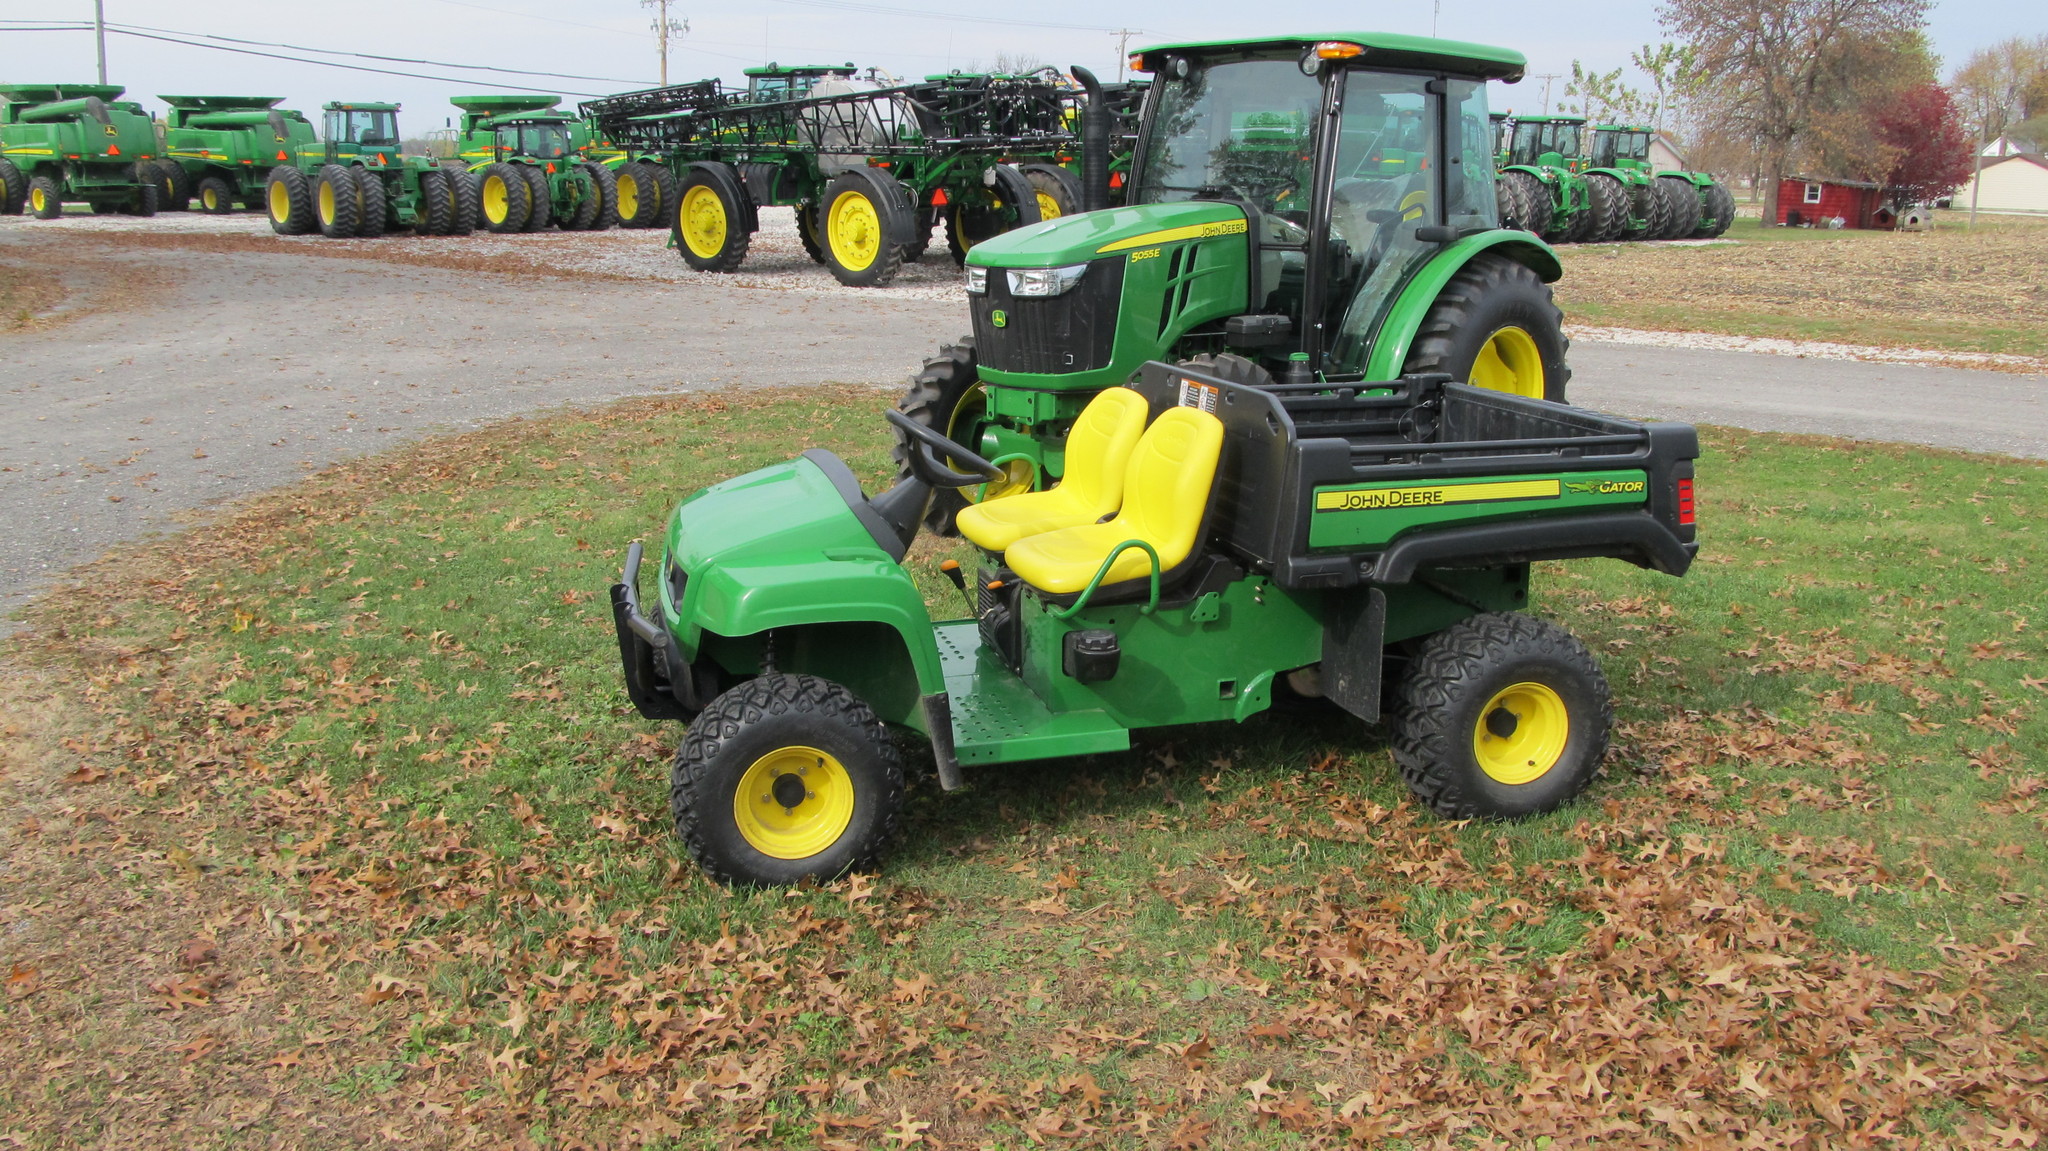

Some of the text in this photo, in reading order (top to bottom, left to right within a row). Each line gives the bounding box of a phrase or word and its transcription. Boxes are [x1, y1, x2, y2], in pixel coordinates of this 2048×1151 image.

[1201, 223, 1245, 237] JOHN DEERE
[1131, 248, 1161, 263] 5055E
[1599, 481, 1645, 494] GATOR
[1340, 490, 1443, 508] JOHN DEERE
